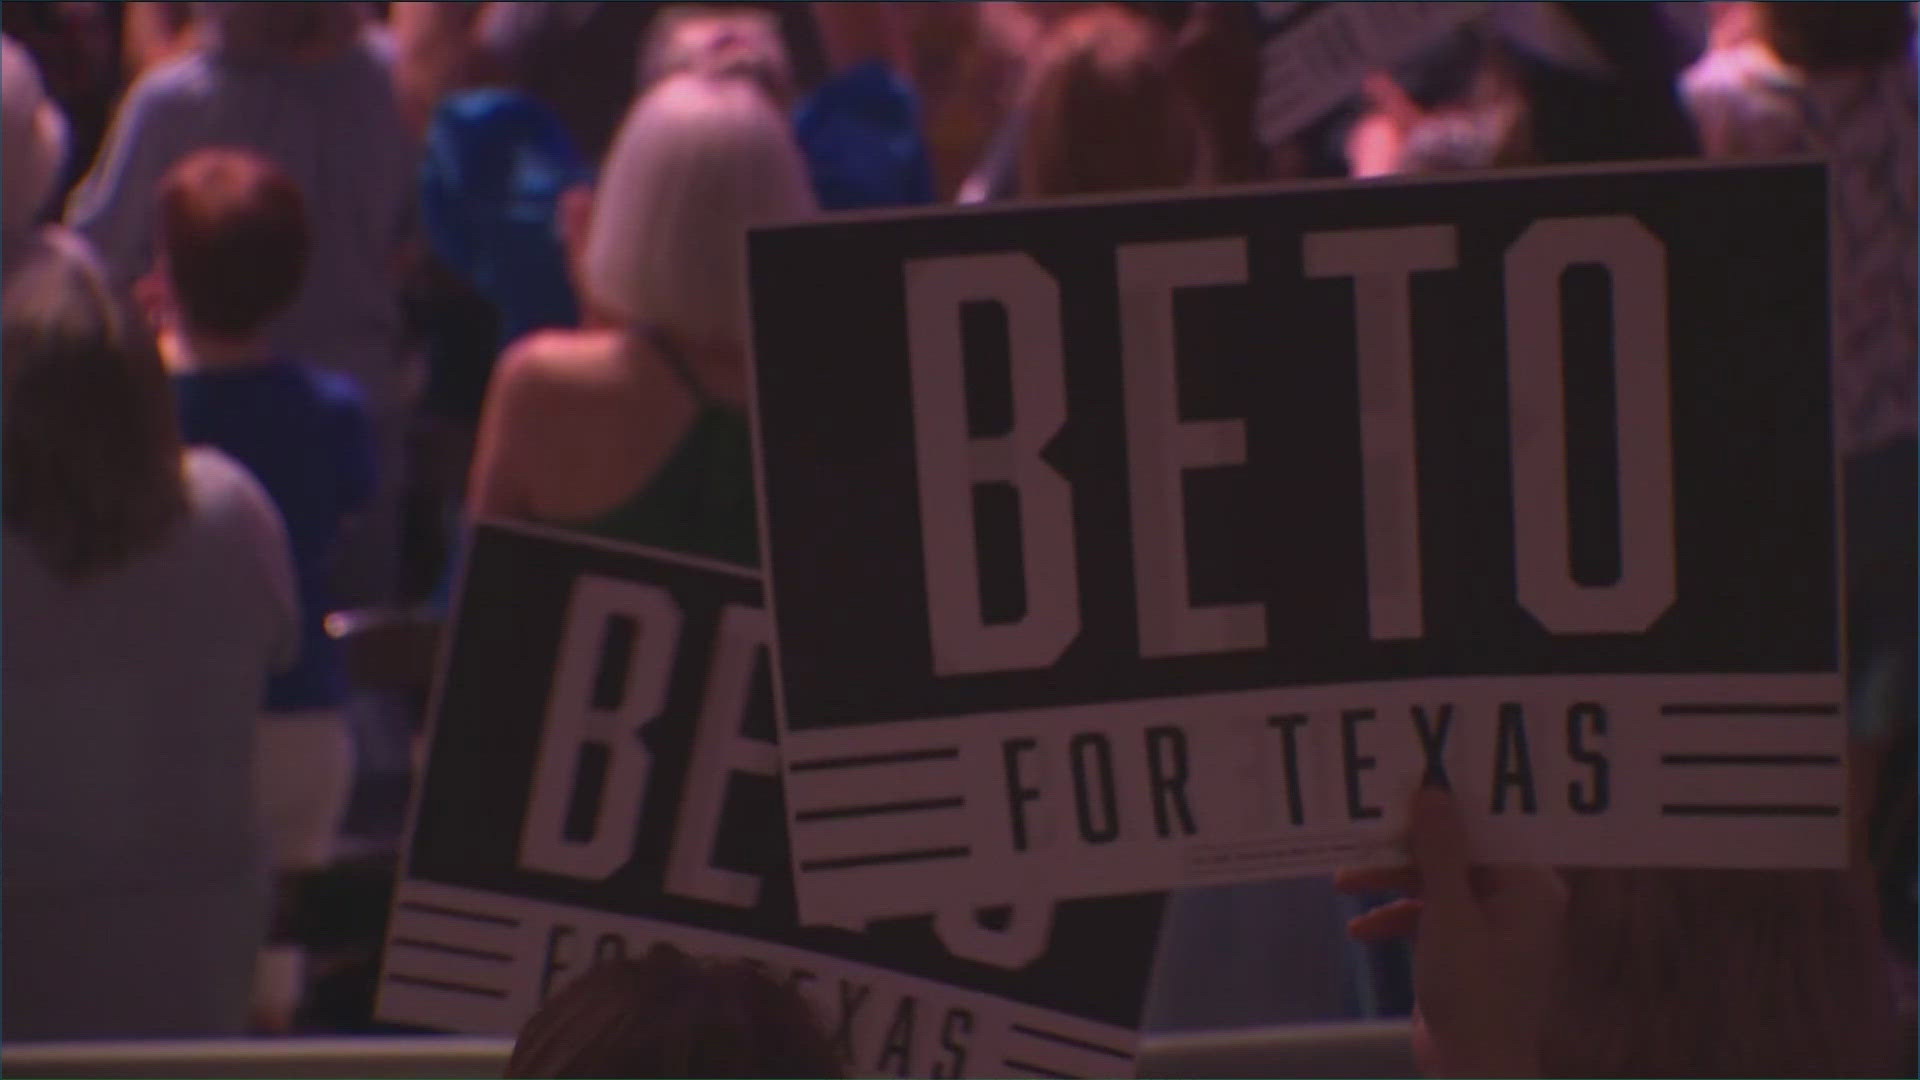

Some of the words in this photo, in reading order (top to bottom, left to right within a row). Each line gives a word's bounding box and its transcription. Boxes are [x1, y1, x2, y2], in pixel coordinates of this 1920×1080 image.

[903, 214, 1678, 676] BETO
[1002, 725, 1198, 852] FOR
[1266, 702, 1611, 826] TEXAS
